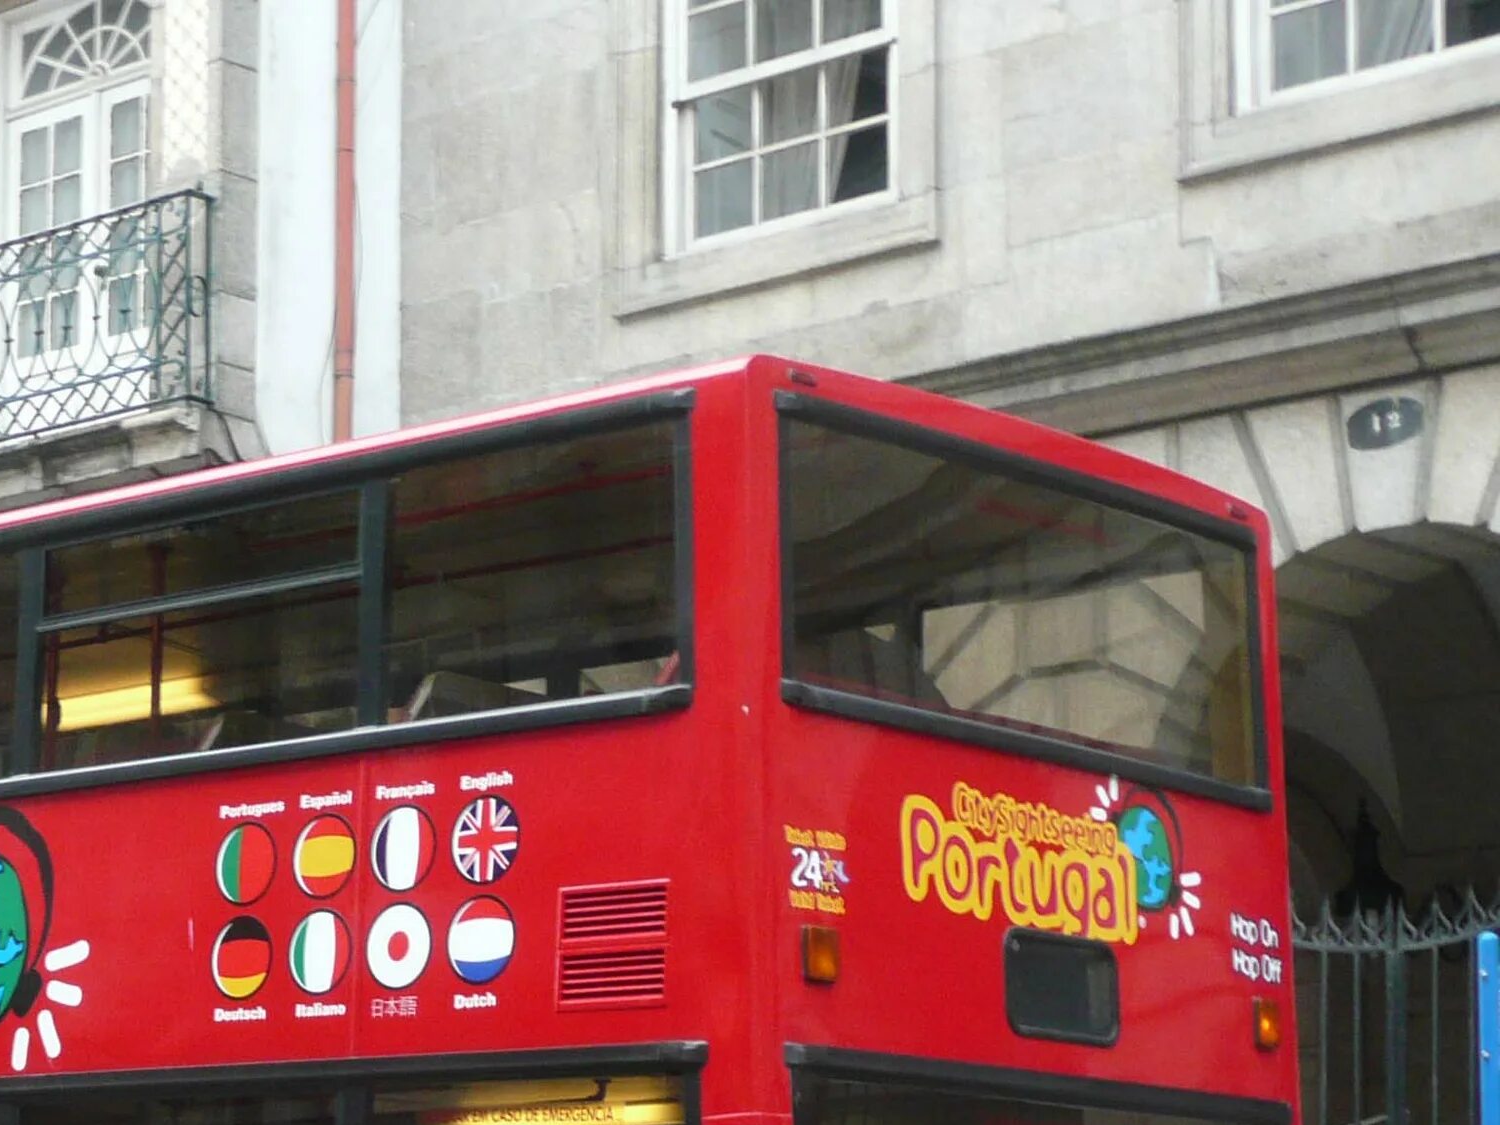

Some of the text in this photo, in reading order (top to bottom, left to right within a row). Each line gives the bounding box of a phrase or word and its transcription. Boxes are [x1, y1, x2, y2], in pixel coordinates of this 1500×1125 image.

[1371, 411, 1402, 433] 12
[374, 780, 437, 800] Français
[459, 770, 514, 791] English
[298, 790, 354, 811] Español
[791, 847, 822, 889] 24
[901, 794, 1137, 945] Portugal
[1230, 911, 1279, 949] Hop On
[1232, 947, 1282, 984] Hop Off
[294, 1001, 347, 1019] Italiano
[370, 994, 419, 1018] 日本語
[453, 990, 498, 1010] Dutch
[213, 1005, 267, 1023] Deutsch
